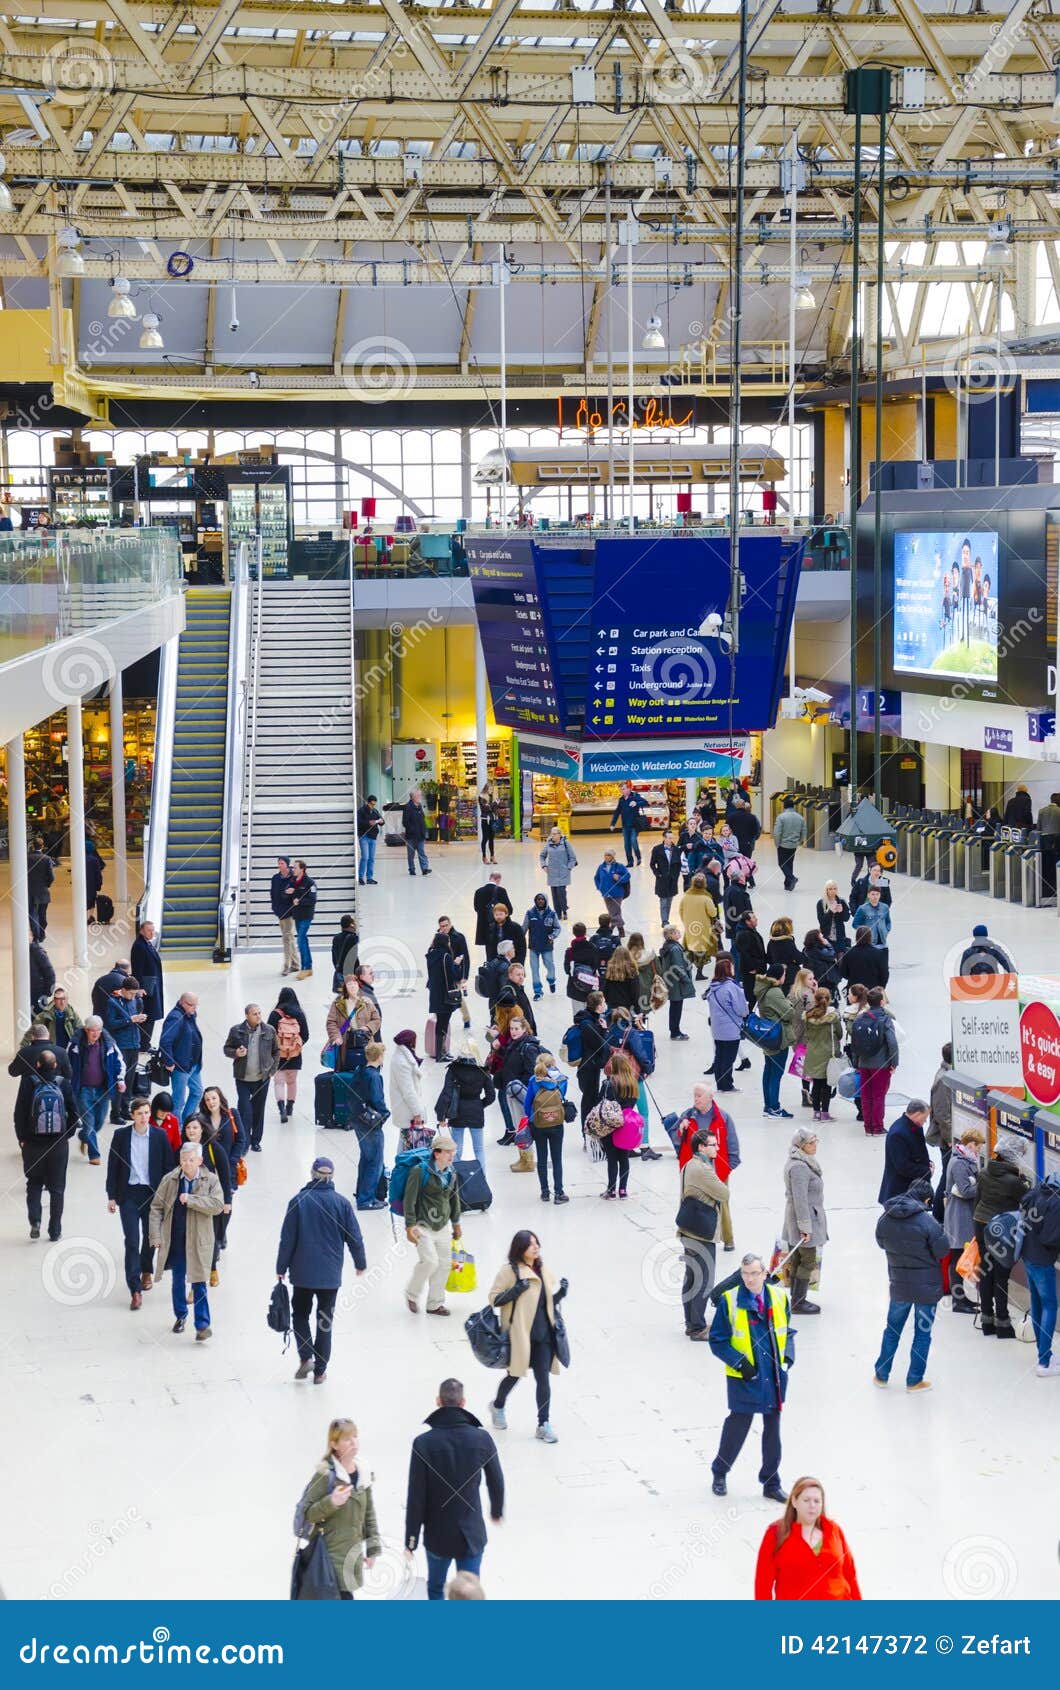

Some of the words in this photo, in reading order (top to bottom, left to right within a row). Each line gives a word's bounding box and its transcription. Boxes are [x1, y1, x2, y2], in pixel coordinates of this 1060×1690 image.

[633, 629, 648, 638] Car
[649, 628, 668, 639] park
[669, 628, 685, 637] and
[631, 645, 662, 655] Station
[663, 645, 702, 656] reception
[630, 663, 652, 672] Taxis
[628, 680, 684, 691] Underground
[628, 698, 647, 709] Way
[648, 698, 665, 707] out
[862, 695, 868, 712] 2
[879, 695, 886, 711] 2
[627, 715, 646, 726] Way
[647, 715, 663, 724] out
[1031, 718, 1038, 737] 3
[1047, 718, 1056, 737] 3
[590, 763, 629, 773] Welcome
[630, 762, 640, 771] to
[641, 760, 682, 770] Waterloo
[683, 759, 716, 769] Station
[961, 1016, 1009, 1035] Self-service
[1022, 1025, 1036, 1048] It's
[1037, 1034, 1060, 1058] quick
[956, 1045, 979, 1063] ticket
[980, 1045, 1020, 1064] machines
[1027, 1053, 1036, 1073] &
[1037, 1061, 1056, 1087] easy
